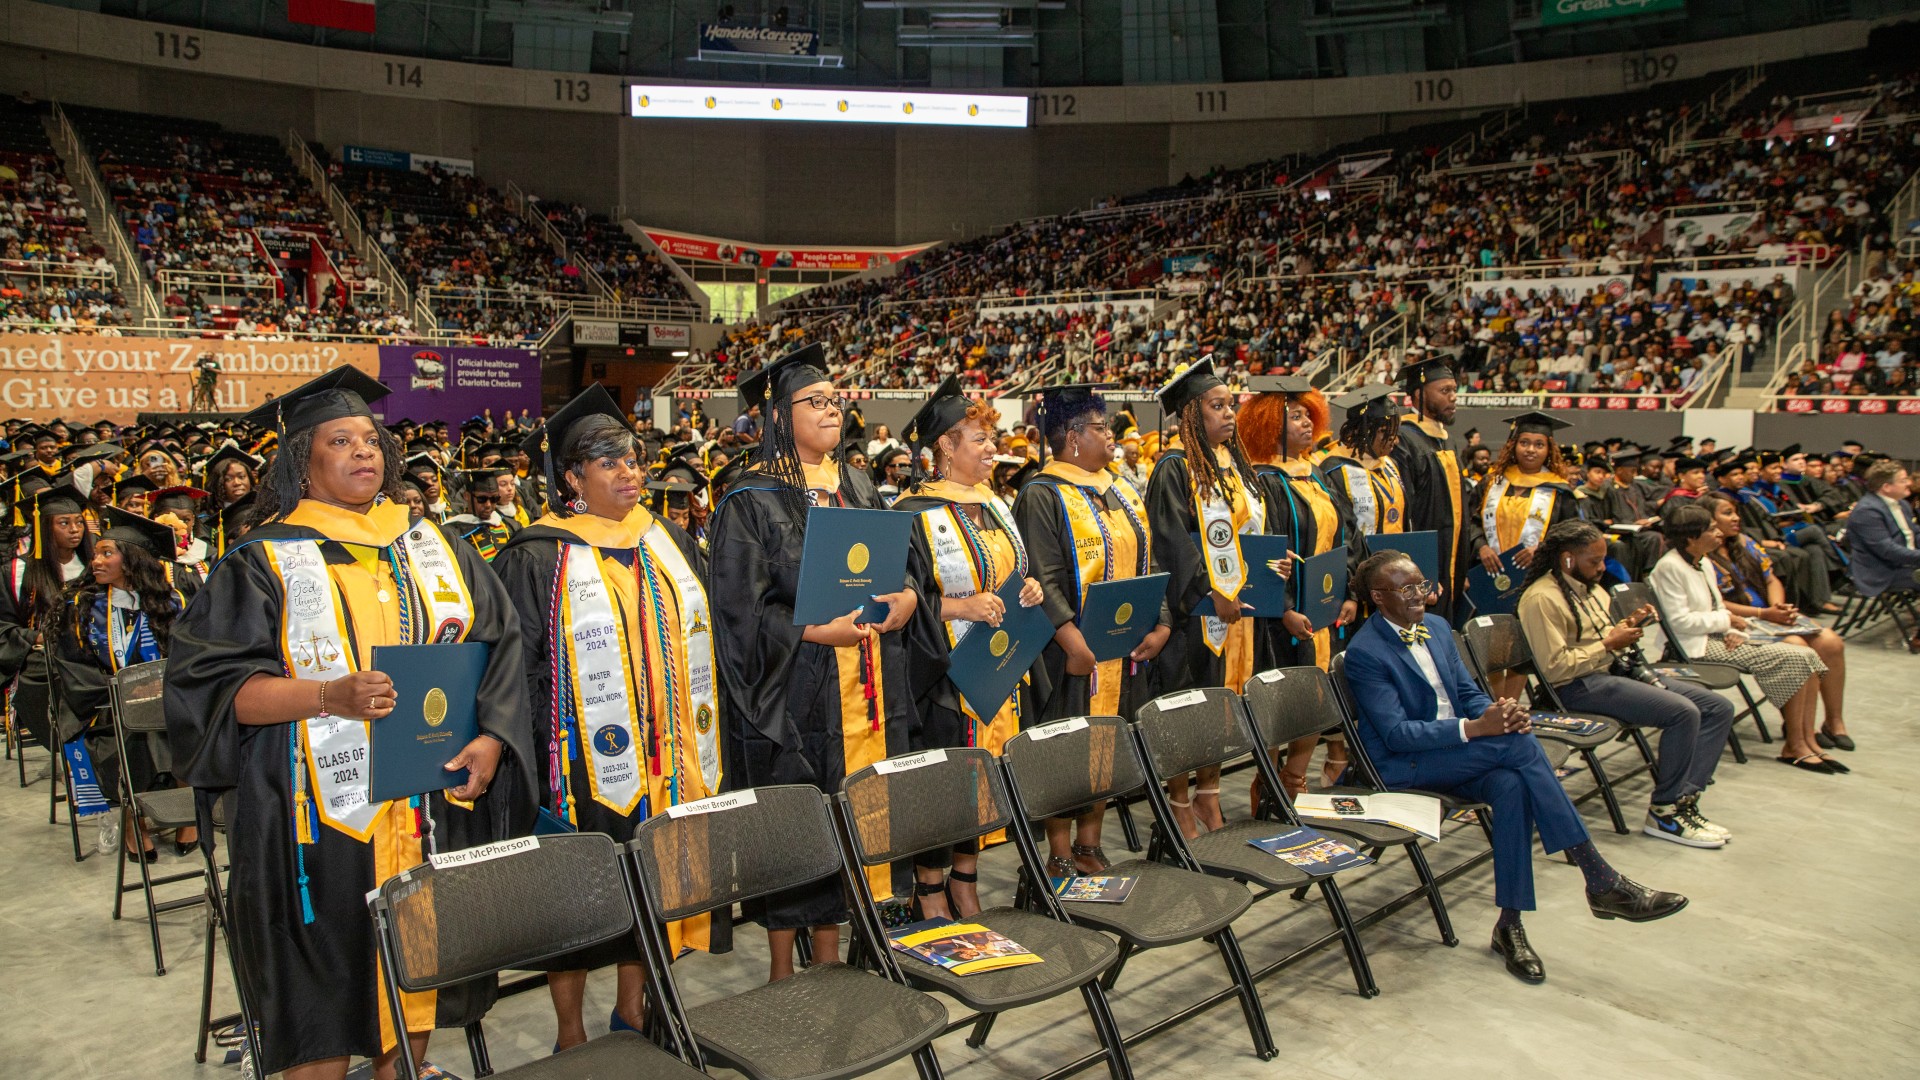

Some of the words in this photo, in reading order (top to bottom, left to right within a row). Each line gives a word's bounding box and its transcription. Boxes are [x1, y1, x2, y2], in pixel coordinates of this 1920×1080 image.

[155, 31, 201, 60] 115
[384, 62, 423, 87] 114
[1630, 54, 1678, 82] 109
[553, 79, 590, 102] 113
[1414, 78, 1453, 101] 110
[1041, 94, 1076, 115] 112
[1196, 91, 1228, 112] 111
[803, 253, 826, 261] People
[653, 326, 685, 338] Bojangles
[73, 345, 161, 376] your
[168, 344, 339, 373] Zmboni?
[457, 359, 482, 367] Official
[484, 359, 519, 368] healthcare
[457, 370, 486, 378] provider
[498, 370, 509, 378] the
[457, 378, 488, 387] Charlotte
[490, 379, 522, 388] Checkers
[2, 378, 97, 408] Give
[107, 387, 150, 408] us
[158, 387, 178, 407] a
[1104, 393, 1125, 401] WHERE
[1467, 396, 1505, 405] FRIENDS
[1507, 396, 1534, 405] MEET
[1076, 538, 1095, 549] CLASS
[1096, 537, 1102, 545] OF
[422, 549, 439, 557] Smith
[1085, 551, 1099, 560] 2024
[568, 578, 602, 592] Evangeline
[574, 629, 603, 642] CLASS
[604, 625, 614, 635] OF
[586, 640, 608, 651] 2024
[588, 671, 612, 682] MASTER
[598, 683, 606, 691] OF
[585, 695, 606, 705] SOCIAL
[606, 692, 623, 702] WORK
[1169, 695, 1193, 706] Reserved
[1043, 723, 1070, 736] Reserved
[318, 751, 351, 769] CLASS
[353, 747, 365, 761] OF
[892, 755, 926, 769] Reserved
[602, 763, 629, 774] 2023-2024
[333, 767, 359, 784] 2024
[602, 773, 633, 785] PRESIDENT
[686, 803, 711, 813] Usher
[711, 797, 738, 809] Brown
[434, 851, 467, 866] Usher
[469, 838, 531, 860] McPherson
